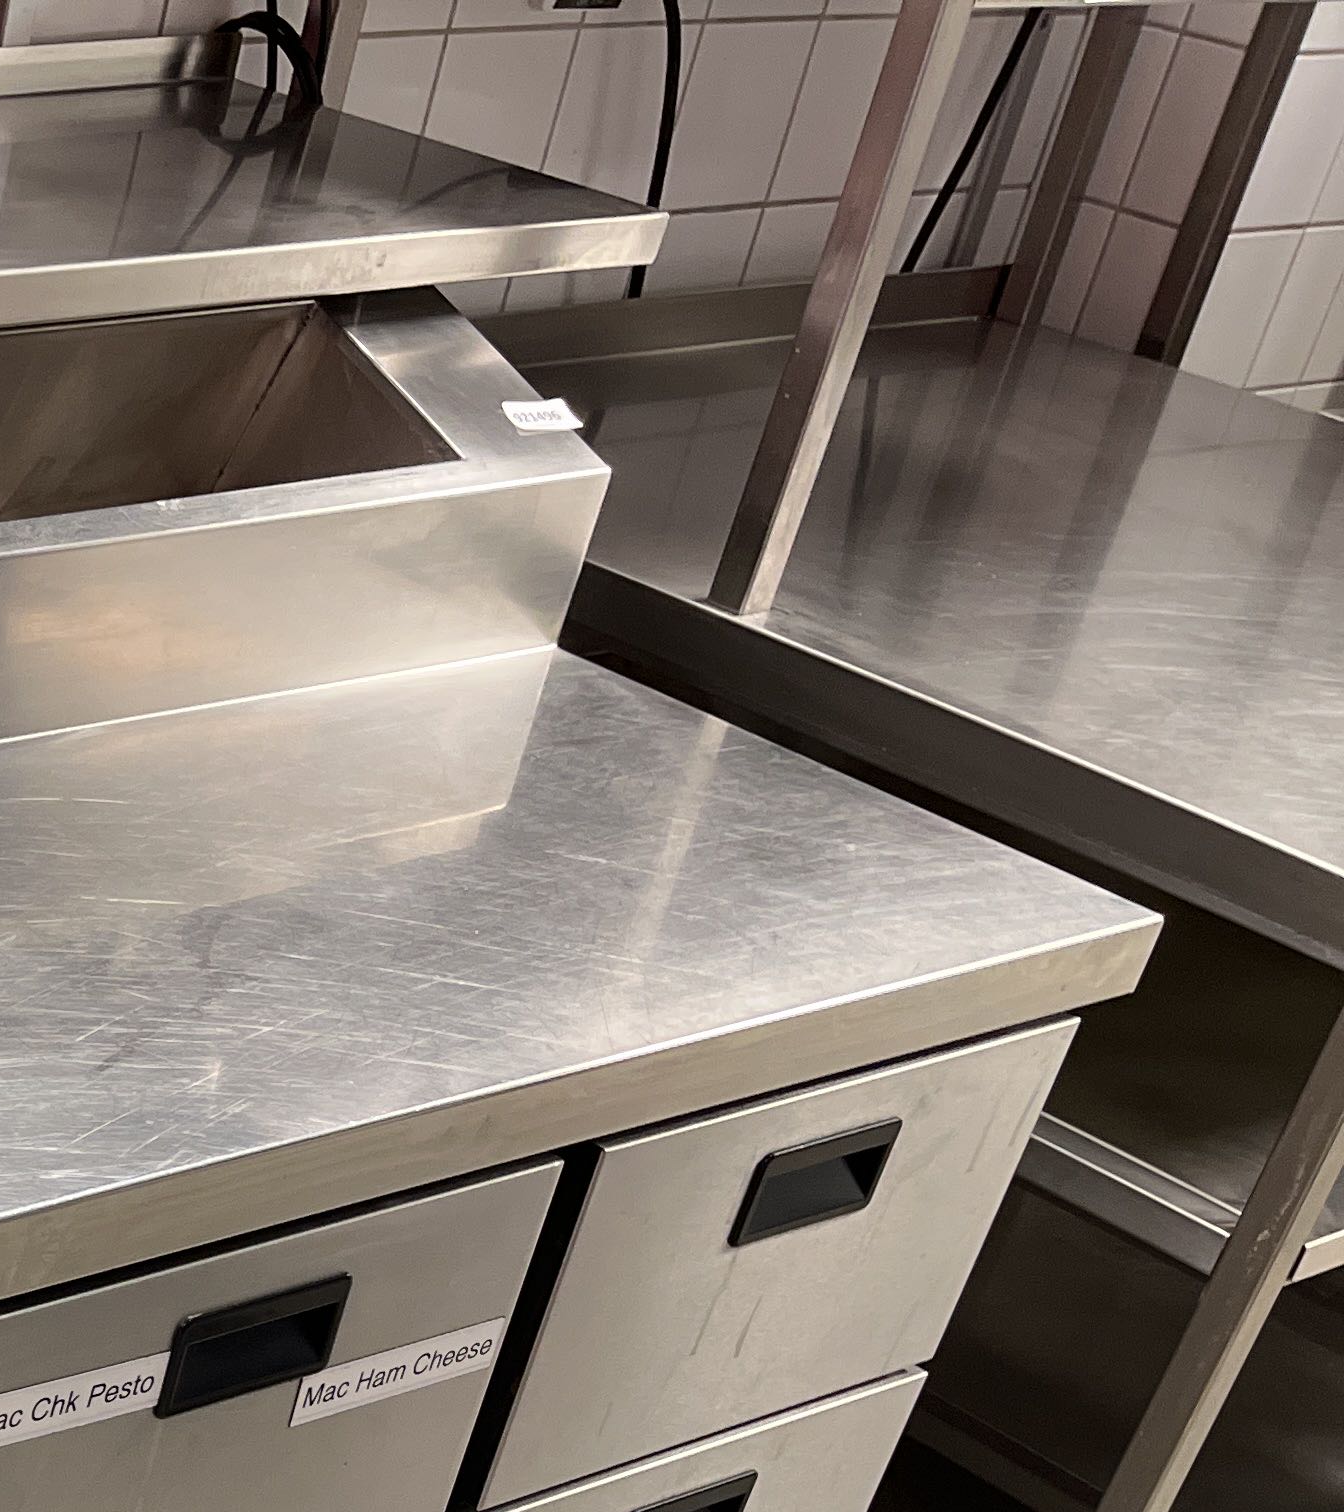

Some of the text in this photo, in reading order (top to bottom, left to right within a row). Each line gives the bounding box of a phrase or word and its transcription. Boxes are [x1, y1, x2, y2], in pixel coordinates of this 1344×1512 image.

[30, 1389, 78, 1422] Chk
[86, 1372, 155, 1408] Pesto
[301, 1335, 494, 1409] Mac Ham Cheese
